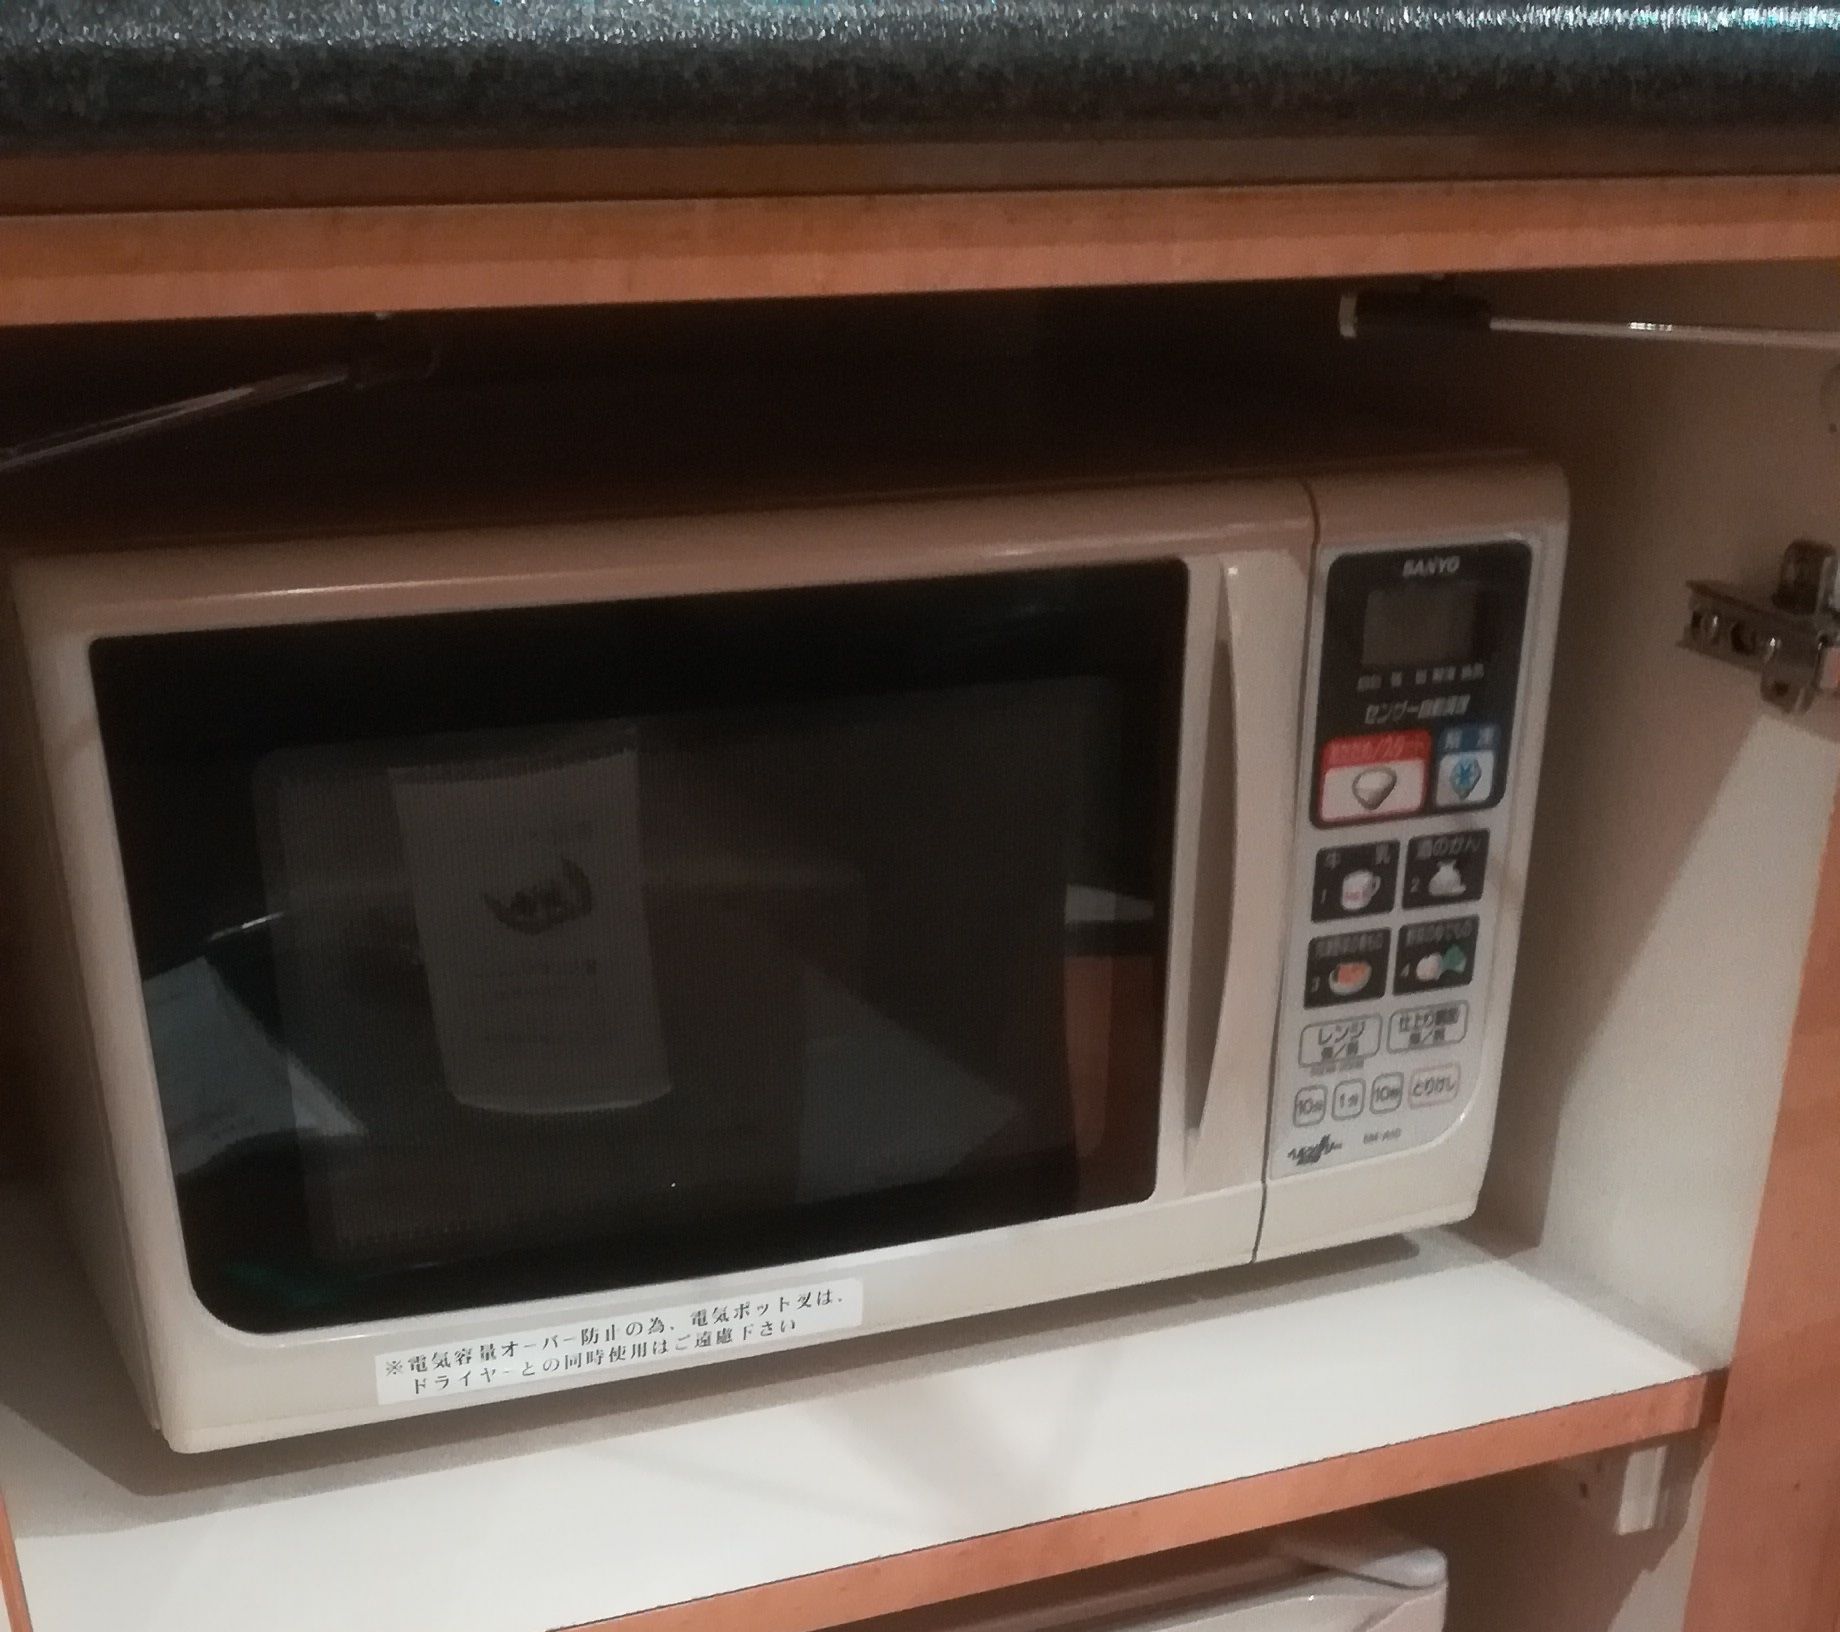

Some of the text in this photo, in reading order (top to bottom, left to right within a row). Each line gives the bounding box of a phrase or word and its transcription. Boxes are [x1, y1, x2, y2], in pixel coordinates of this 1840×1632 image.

[1402, 556, 1460, 577] SANYO
[1317, 1020, 1366, 1046] レンジ
[1412, 1075, 1455, 1098] とりけし
